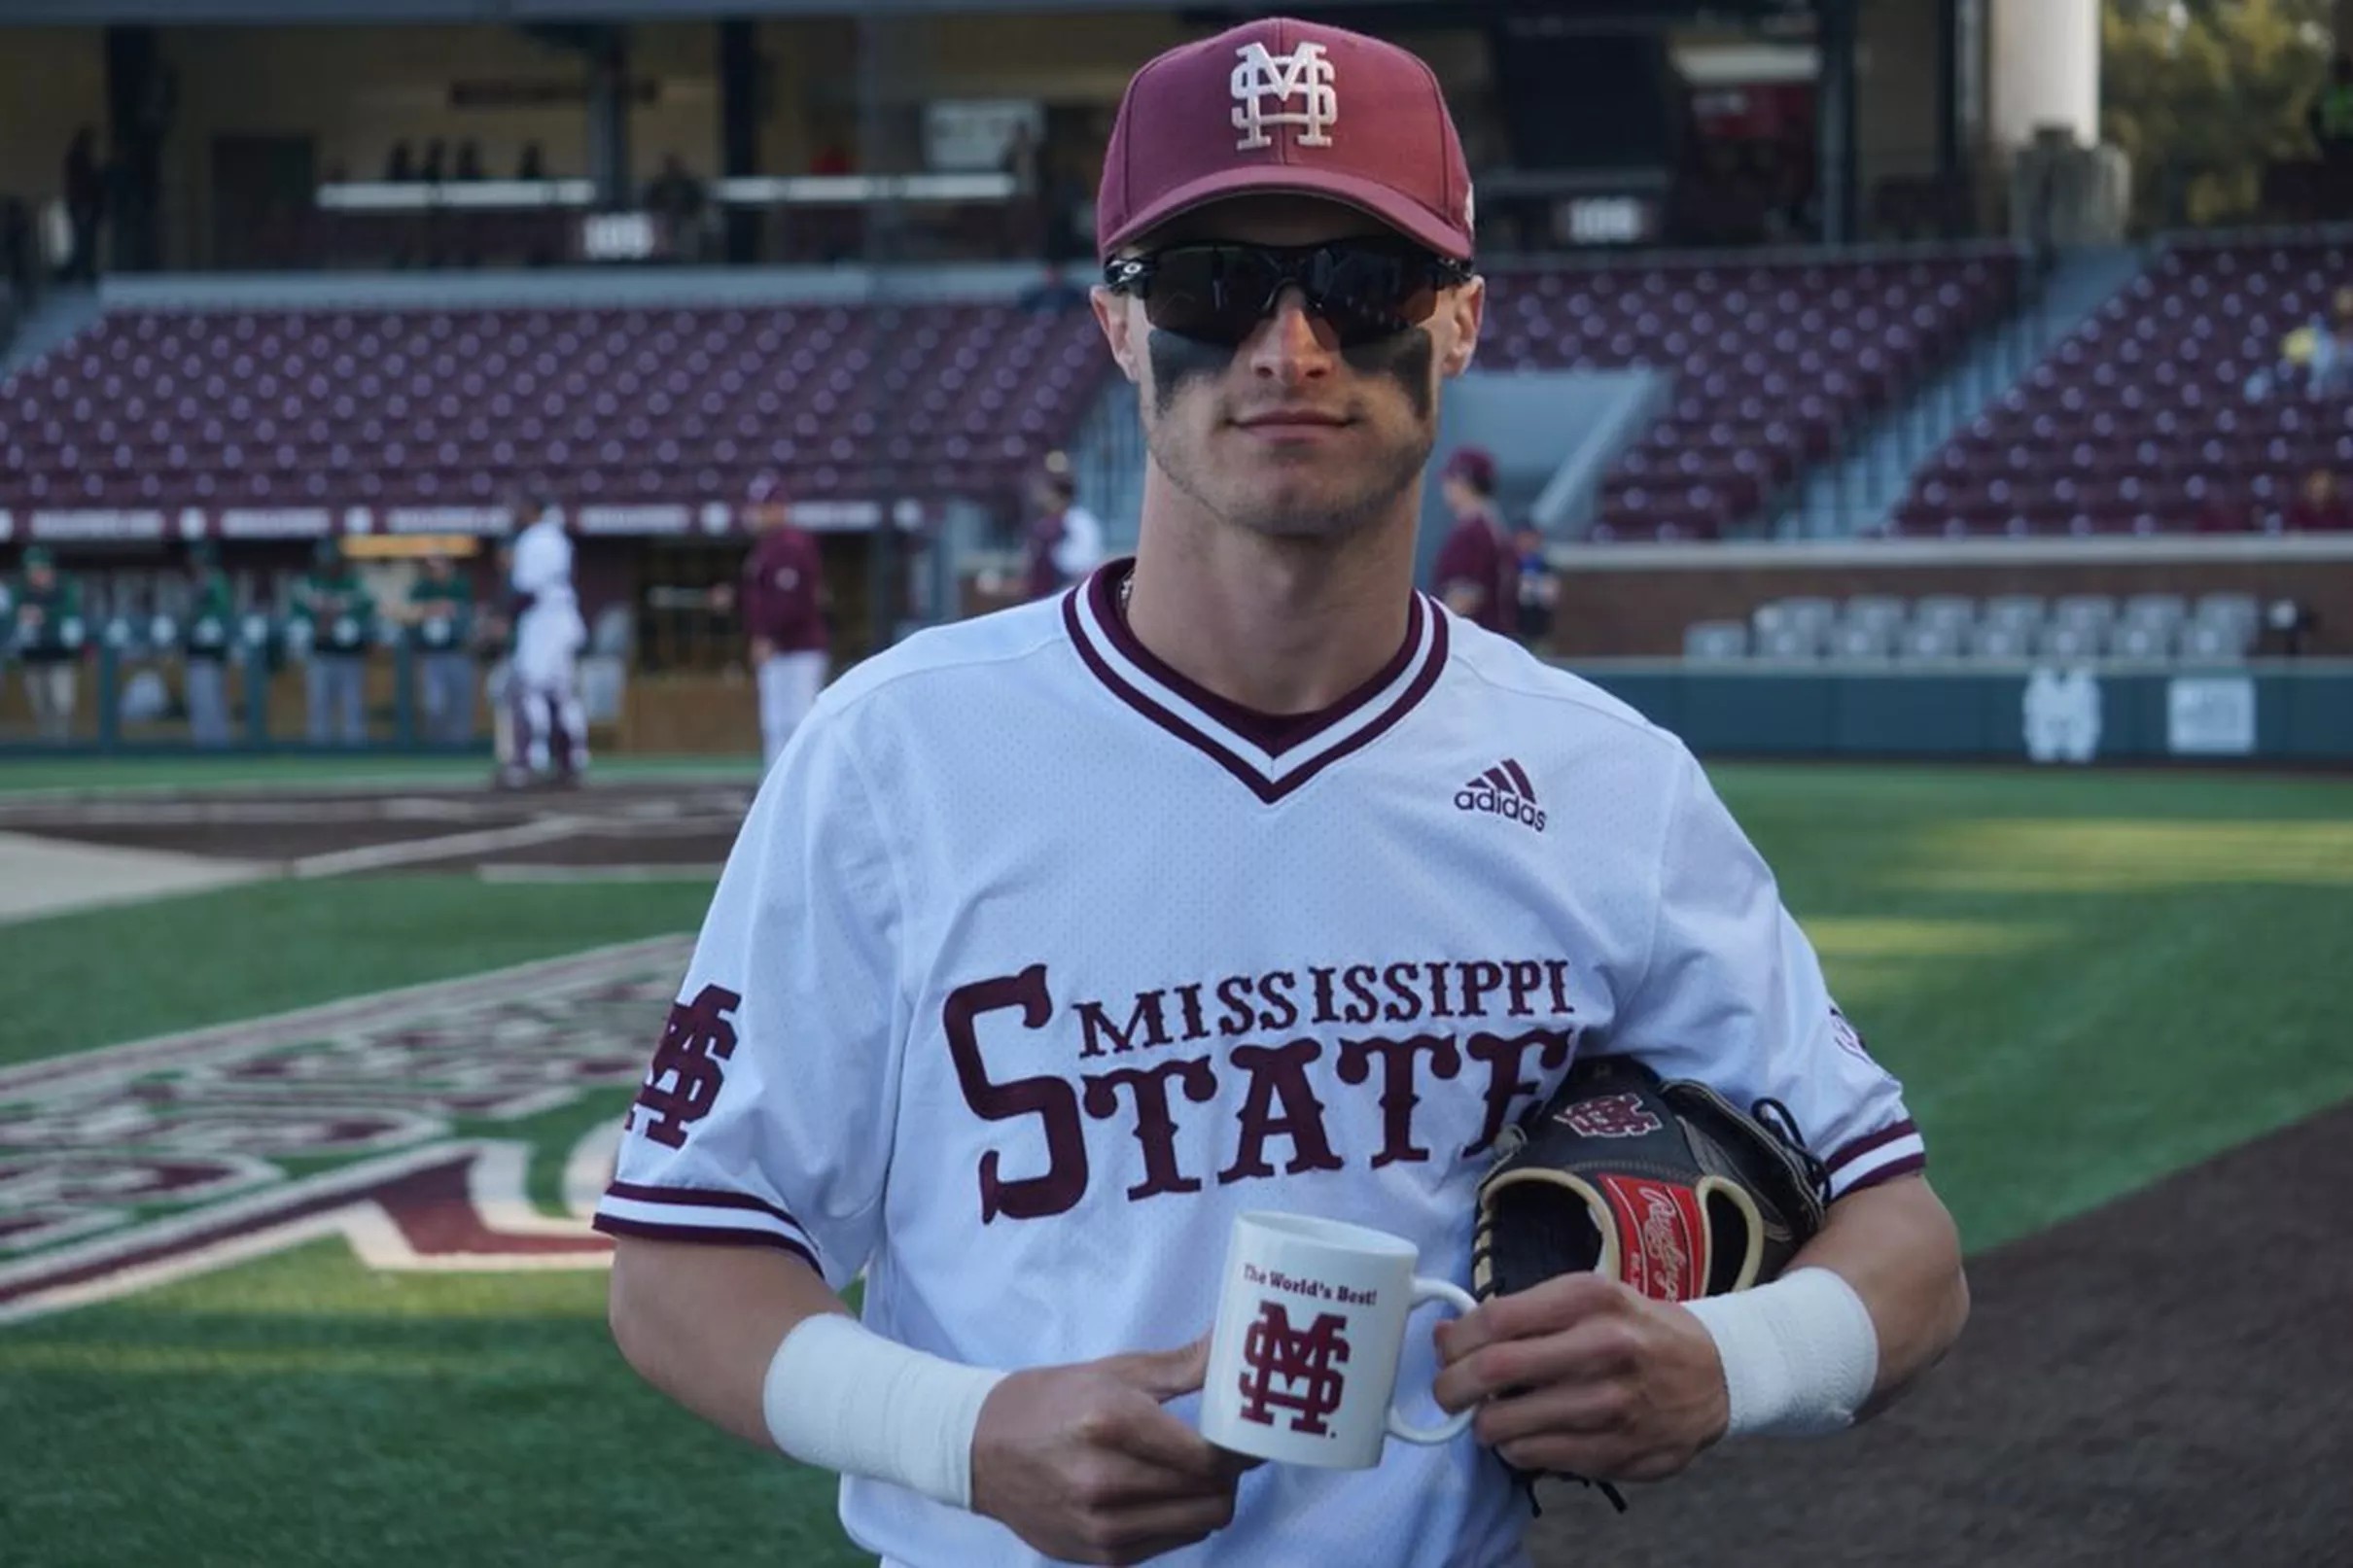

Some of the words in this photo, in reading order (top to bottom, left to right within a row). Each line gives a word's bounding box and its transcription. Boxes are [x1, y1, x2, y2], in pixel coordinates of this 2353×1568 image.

[1454, 787, 1547, 832] adidas
[1071, 959, 1576, 1058] MISSISSIPPI
[1244, 1263, 1266, 1285] The
[1270, 1270, 1332, 1300] World's
[1337, 1284, 1378, 1307] Best!
